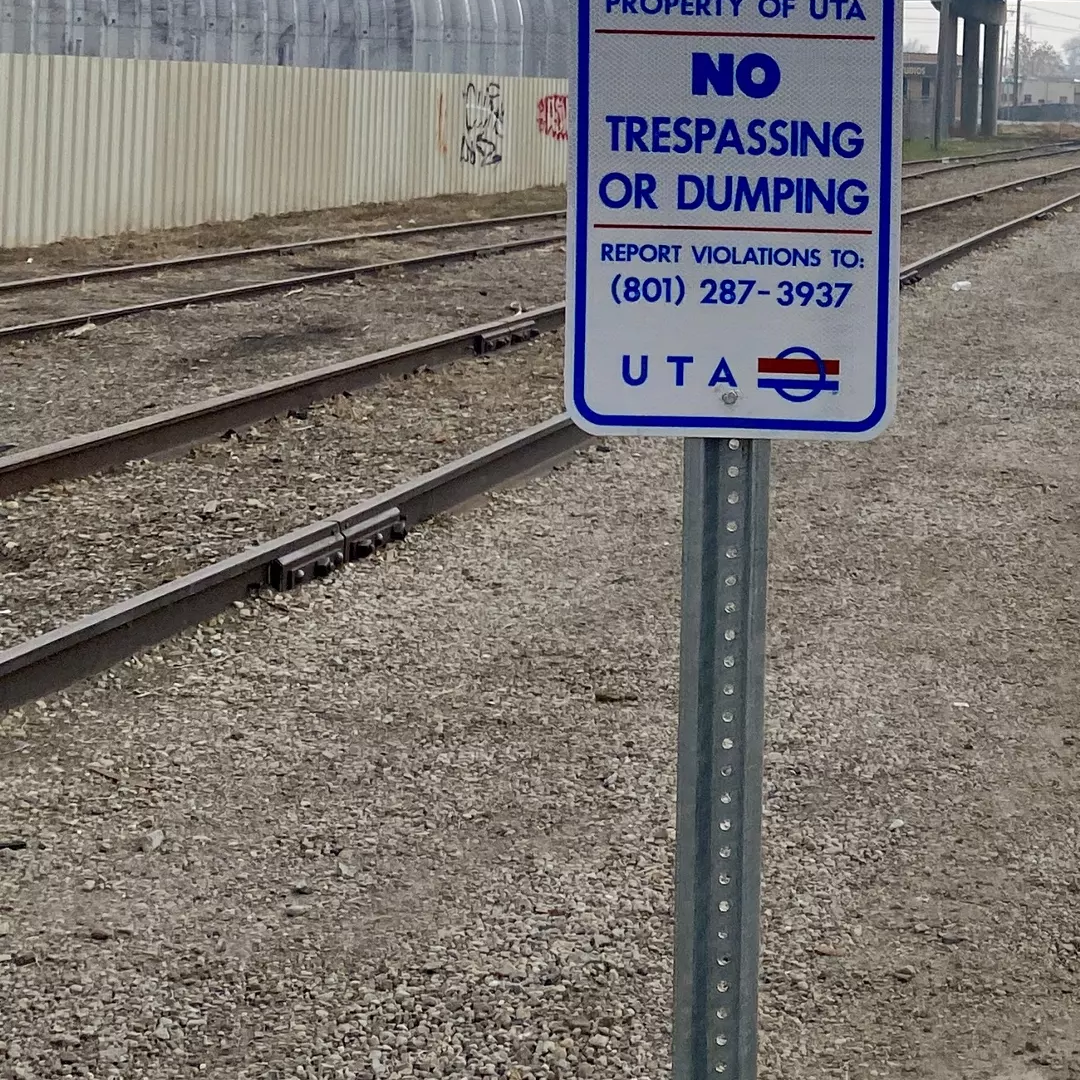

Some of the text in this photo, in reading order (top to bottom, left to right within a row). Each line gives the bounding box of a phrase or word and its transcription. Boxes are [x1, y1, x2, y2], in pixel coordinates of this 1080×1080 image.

[691, 52, 781, 99] NO
[903, 67, 926, 75] UDIOS
[605, 115, 864, 159] TRESPASSING
[598, 172, 870, 216] OR DUMPING
[600, 243, 865, 269] REPORT VIOLATIONS TO:
[610, 273, 853, 308] (801) 287-3937
